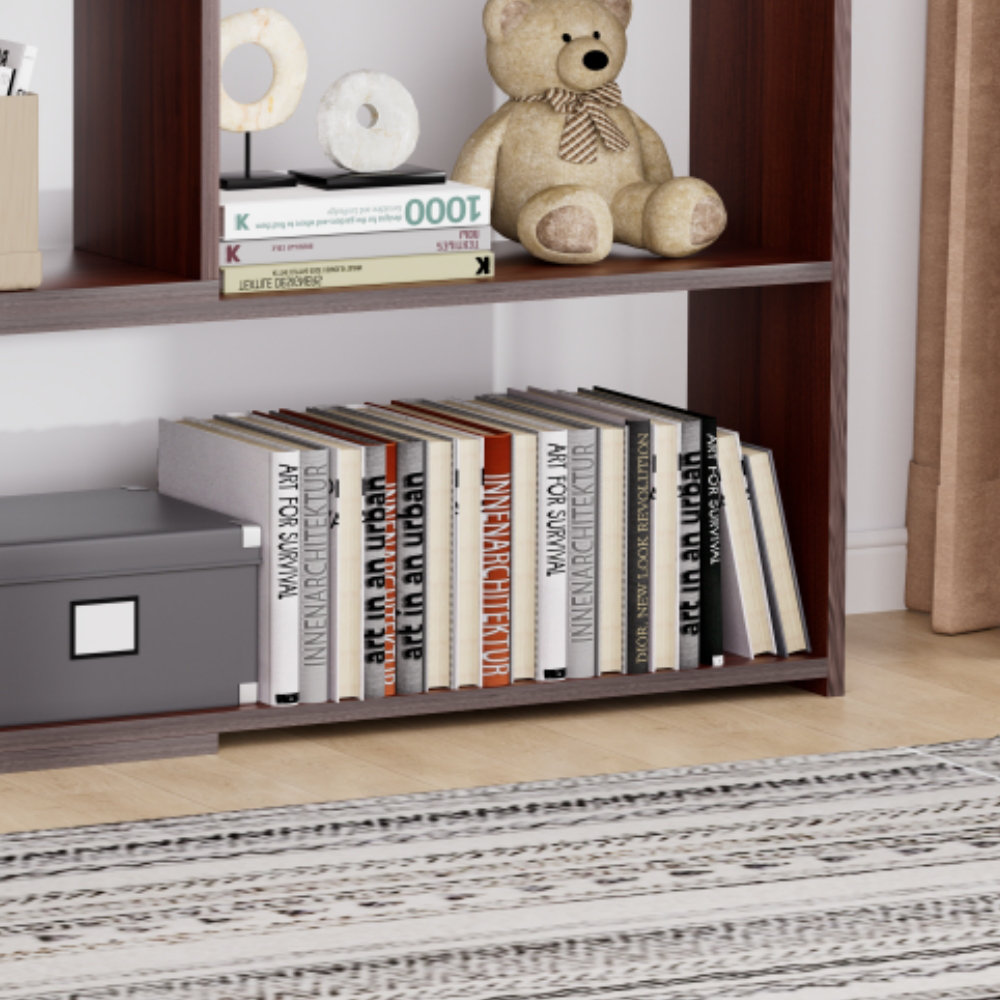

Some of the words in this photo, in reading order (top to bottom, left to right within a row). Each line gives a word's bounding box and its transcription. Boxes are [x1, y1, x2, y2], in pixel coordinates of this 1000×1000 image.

[405, 195, 482, 227] 1000
[547, 443, 567, 470] ART
[279, 464, 298, 491] ART
[547, 476, 567, 505] FOR
[636, 432, 650, 533] REVOLUTION
[680, 451, 701, 527] urban
[707, 465, 720, 494] FOR
[278, 497, 298, 528] FOR
[363, 474, 385, 552] urban
[396, 471, 423, 549] urban
[546, 510, 567, 578] SURVIVAL
[570, 442, 595, 644] INNENARCHITEKTUR
[680, 533, 701, 563] an
[708, 499, 722, 566] SURVIVAL
[278, 532, 298, 600] SURVIVAL
[303, 464, 328, 668] INNENARCHITEKTUR
[365, 557, 385, 590] an
[401, 553, 423, 587] an
[482, 473, 511, 677] INNENARCHITEKTUR
[636, 537, 650, 580] LOOK
[680, 570, 701, 595] in
[364, 595, 385, 621] in
[396, 591, 423, 618] in
[636, 583, 650, 619] NEW
[680, 602, 701, 638] art
[363, 627, 385, 665] art
[396, 624, 423, 661] art
